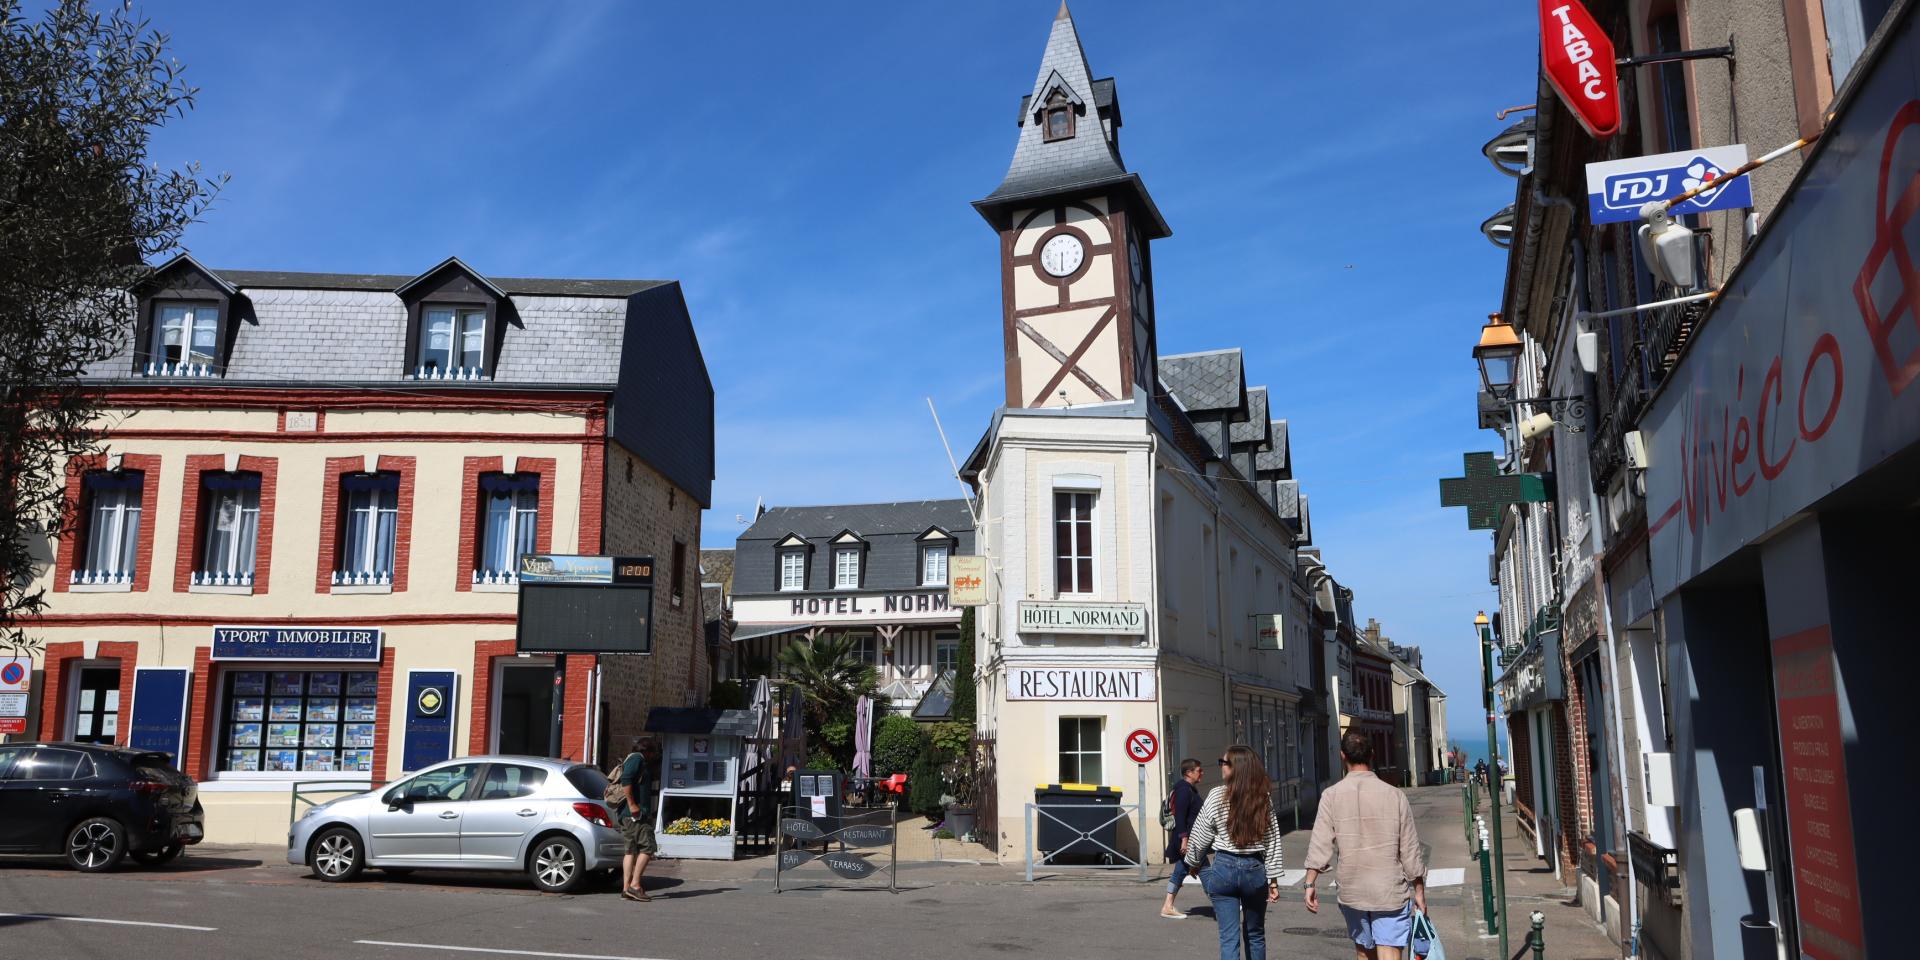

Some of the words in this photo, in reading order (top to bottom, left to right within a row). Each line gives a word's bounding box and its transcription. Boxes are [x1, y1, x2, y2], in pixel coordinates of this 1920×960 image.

[1552, 5, 1606, 100] TABAC
[1612, 174, 1669, 202] FDJ
[791, 597, 862, 616] HOTEL
[885, 593, 963, 613] NORM
[1024, 609, 1063, 624] HOTEL
[1072, 610, 1140, 626] NORMAND
[219, 630, 270, 643] YPORT
[276, 630, 371, 644] IMMOBILIER
[1020, 670, 1143, 698] RESTAURANT
[786, 821, 812, 833] HÔTEL
[843, 829, 887, 839] RESTAURANT
[783, 854, 799, 865] BAR
[829, 859, 864, 872] TERRASSE
